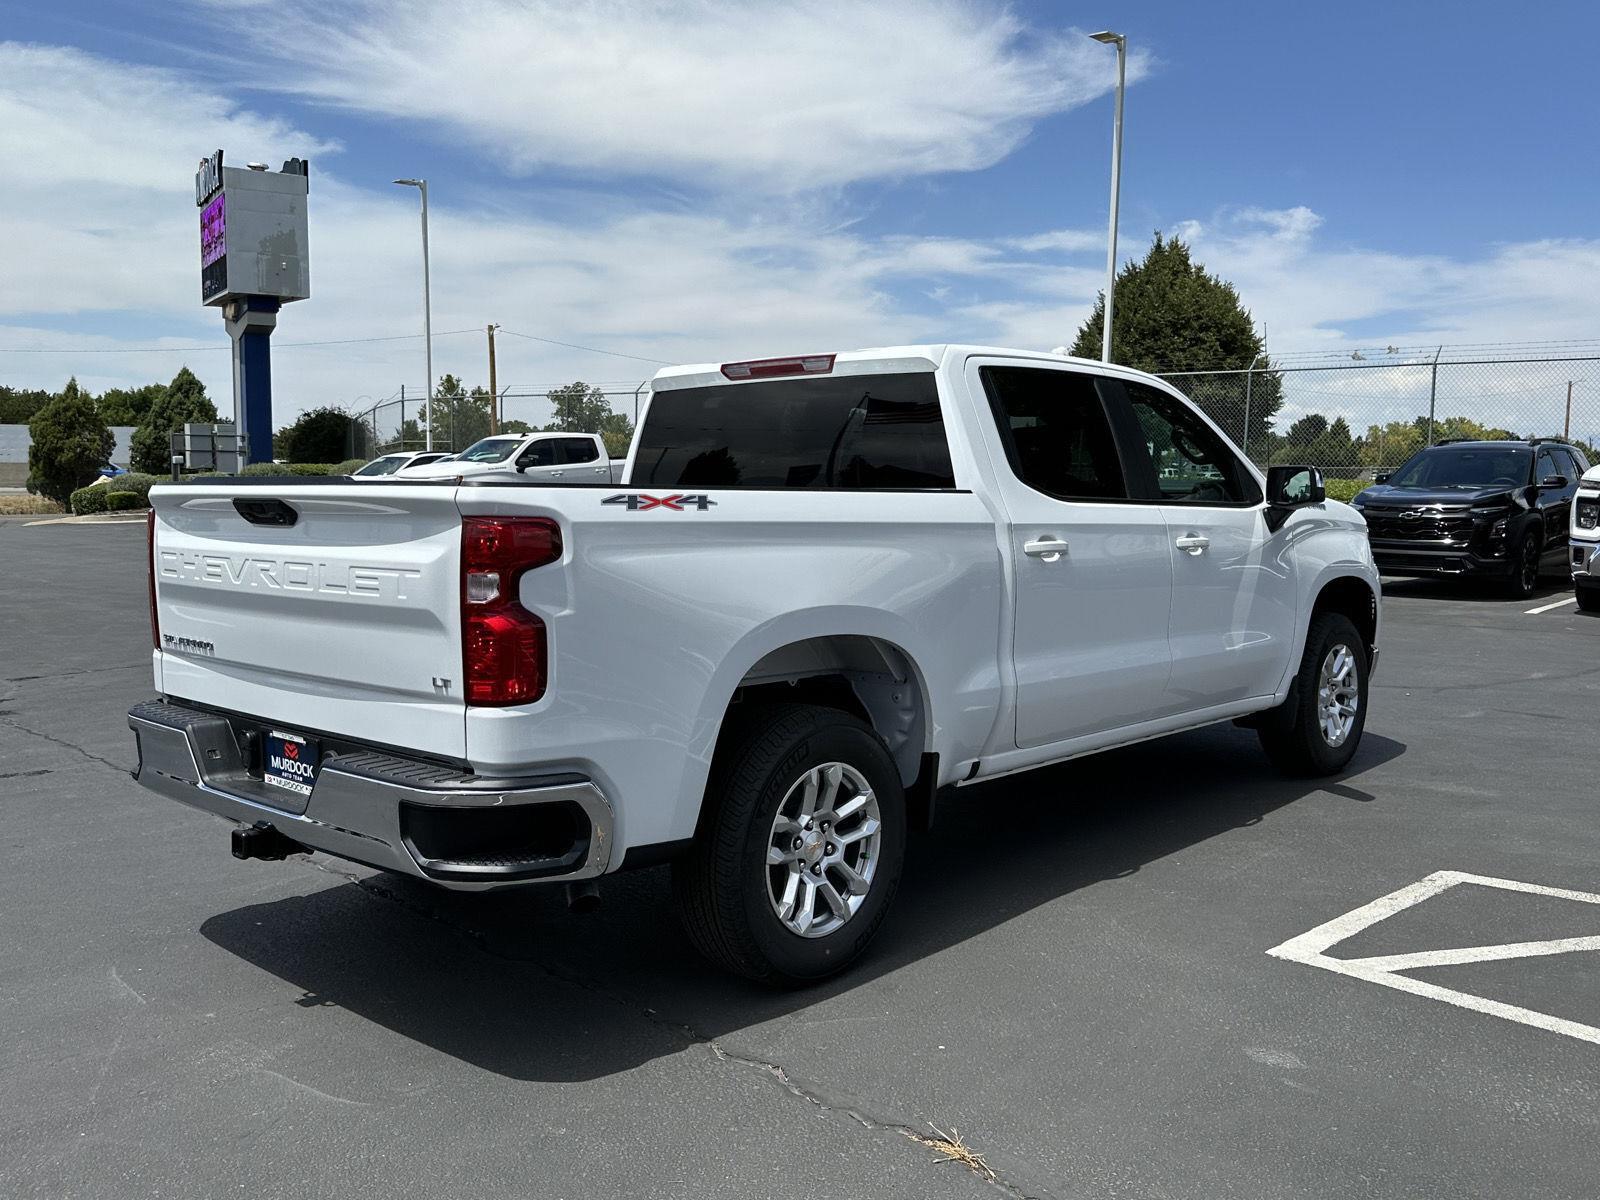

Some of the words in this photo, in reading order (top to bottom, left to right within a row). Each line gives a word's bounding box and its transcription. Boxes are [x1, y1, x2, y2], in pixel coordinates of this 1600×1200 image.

[160, 550, 421, 600] CHEVROLET
[432, 676, 452, 689] LT
[271, 755, 314, 779] MURDOCK
